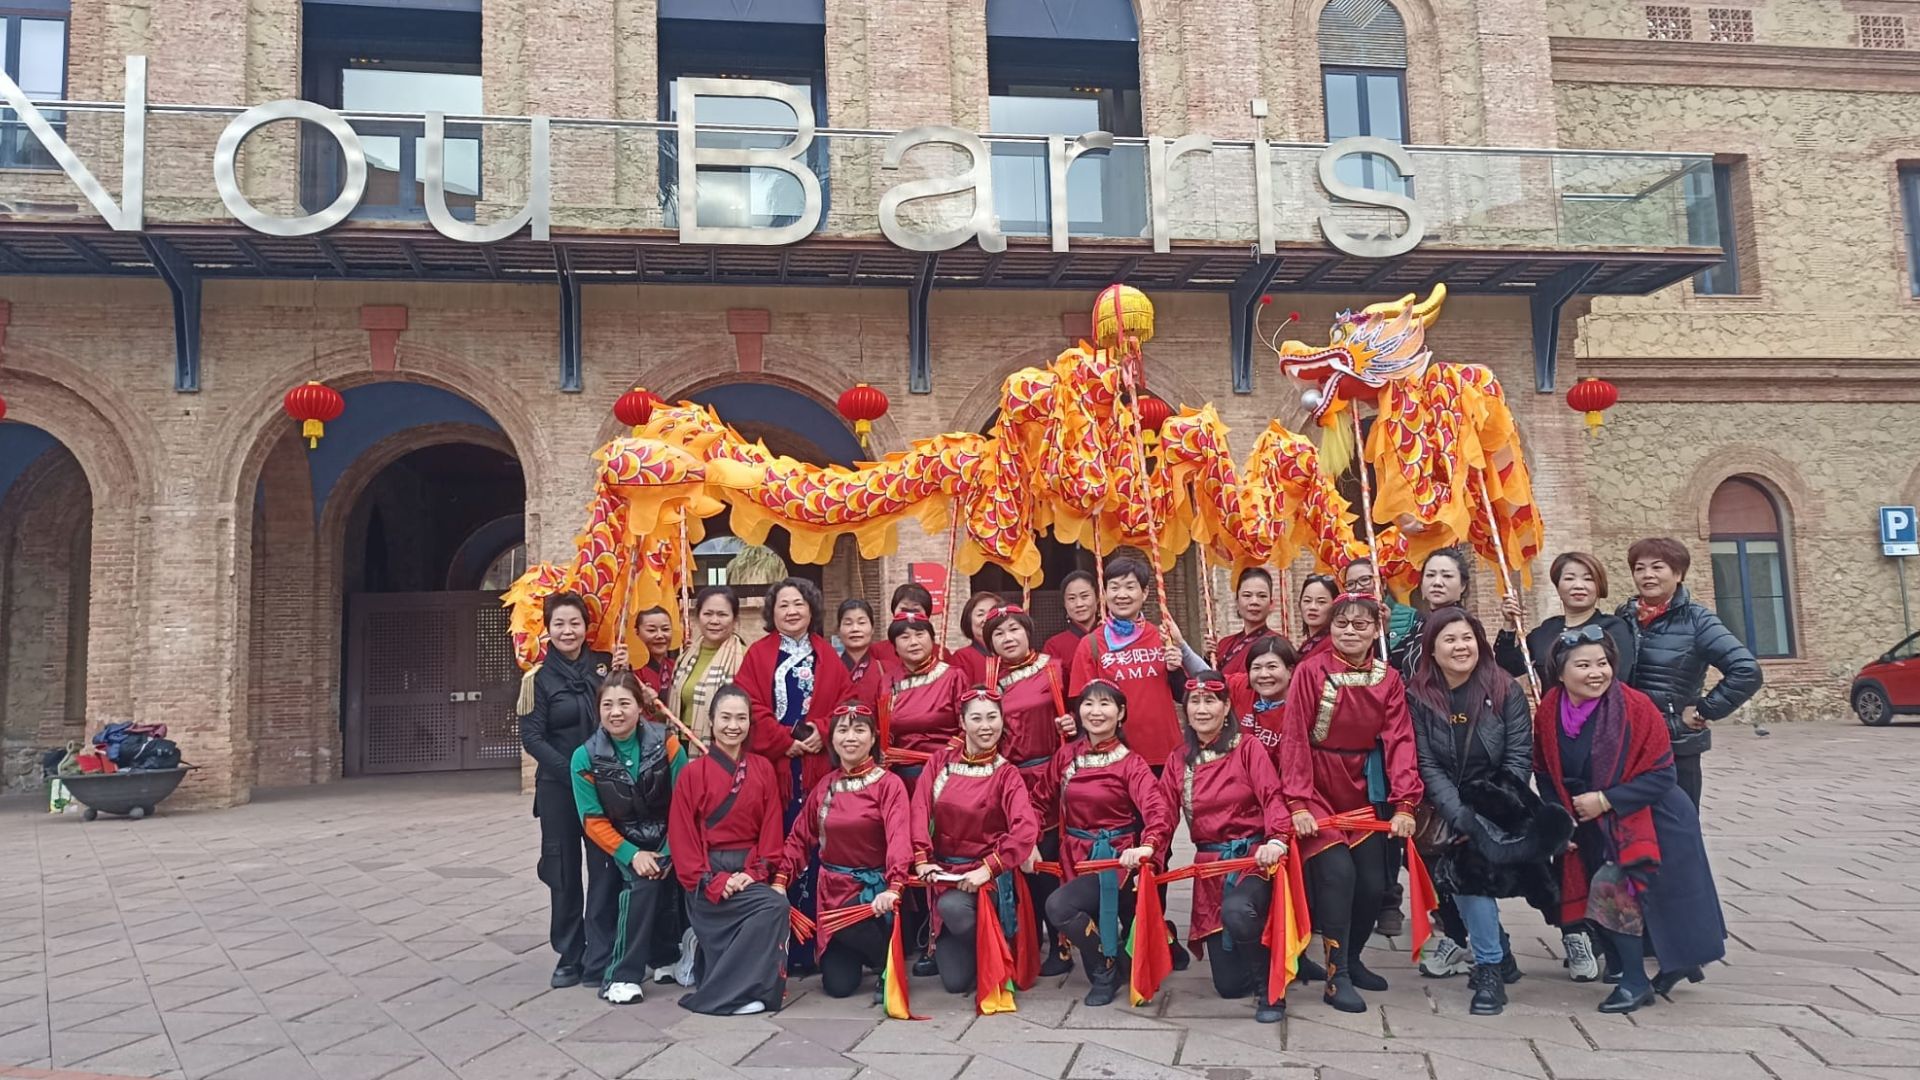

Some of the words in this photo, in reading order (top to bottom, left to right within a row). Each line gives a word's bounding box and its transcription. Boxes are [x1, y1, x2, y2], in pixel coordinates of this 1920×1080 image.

[0, 55, 550, 242] Nou
[678, 77, 1425, 258] Barris
[1887, 511, 1909, 539] P
[1100, 646, 1165, 669] 多彩阳光
[1115, 665, 1158, 681] AMA
